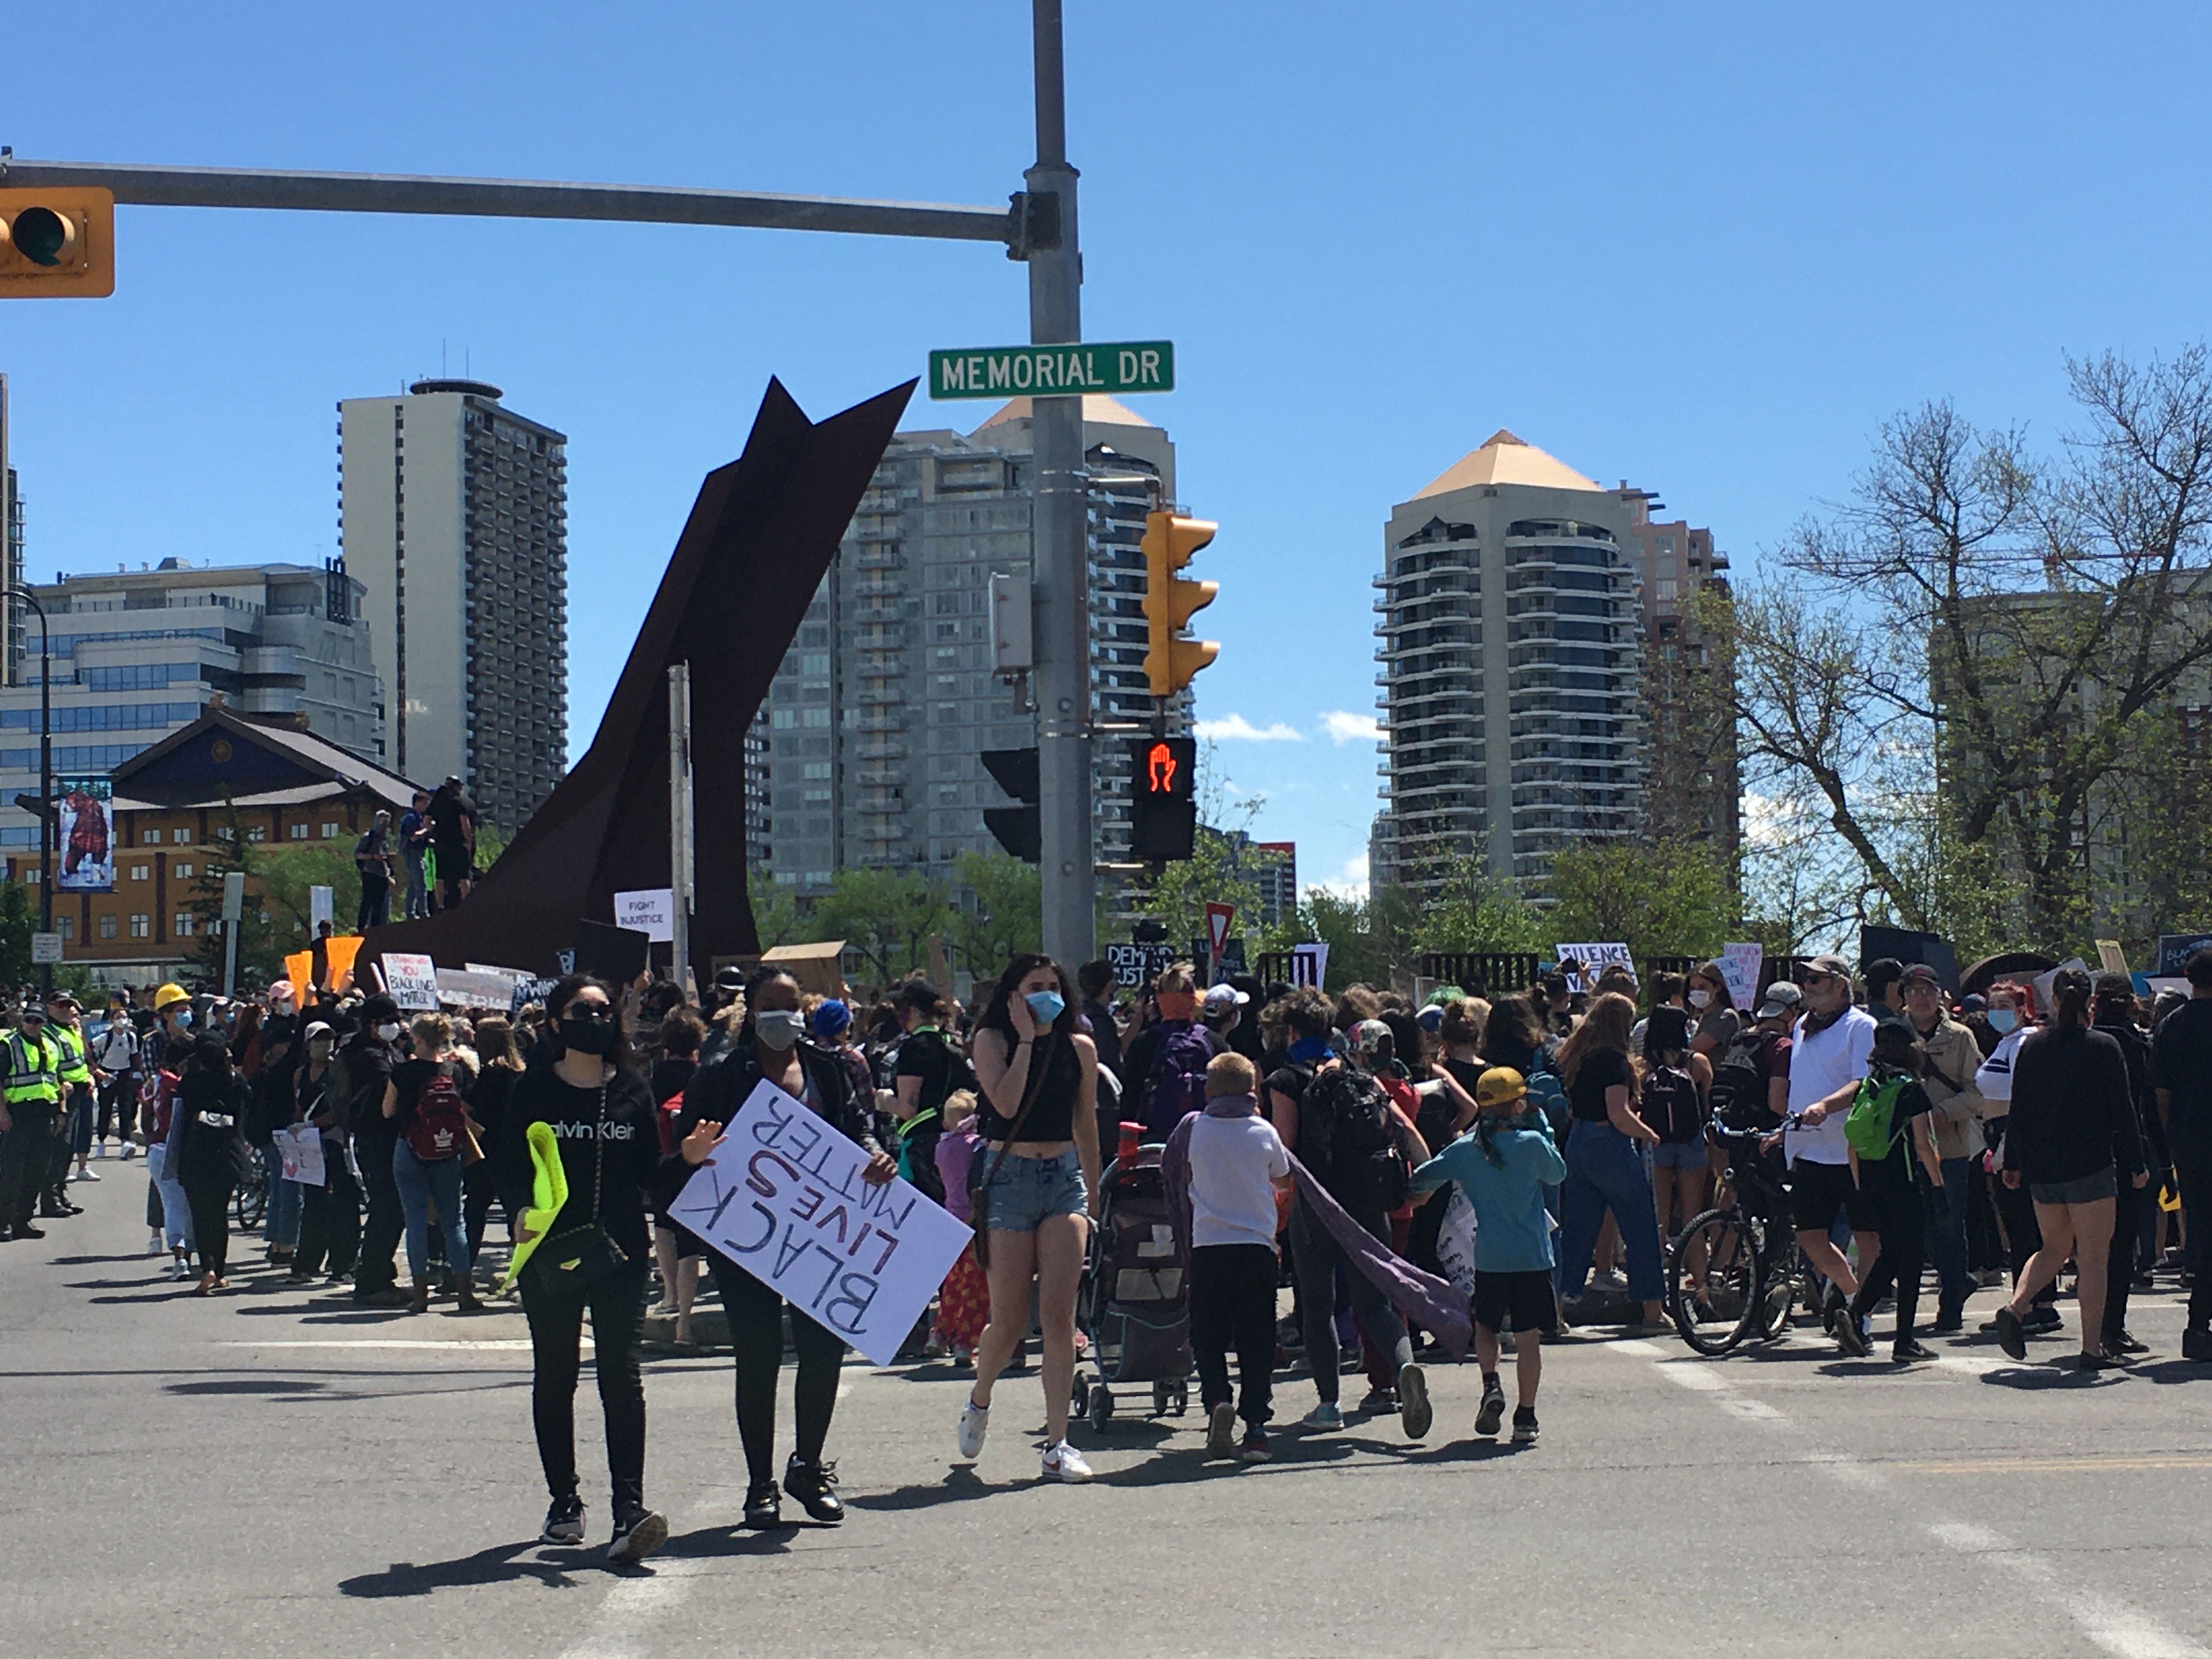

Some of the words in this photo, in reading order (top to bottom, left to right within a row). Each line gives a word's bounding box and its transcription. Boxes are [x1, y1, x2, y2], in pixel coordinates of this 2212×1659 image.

[942, 352, 1105, 391] MEMORIAL
[1119, 350, 1160, 384] DR
[629, 901, 656, 911] FIGHT
[620, 914, 663, 925] INJUSTICE
[1561, 946, 1631, 962] SILENCE
[400, 966, 419, 976] YOU
[550, 1120, 593, 1139] alvin
[752, 1096, 917, 1231] MATTER
[745, 1149, 899, 1276] LIVES
[680, 1169, 879, 1335] BLACK
